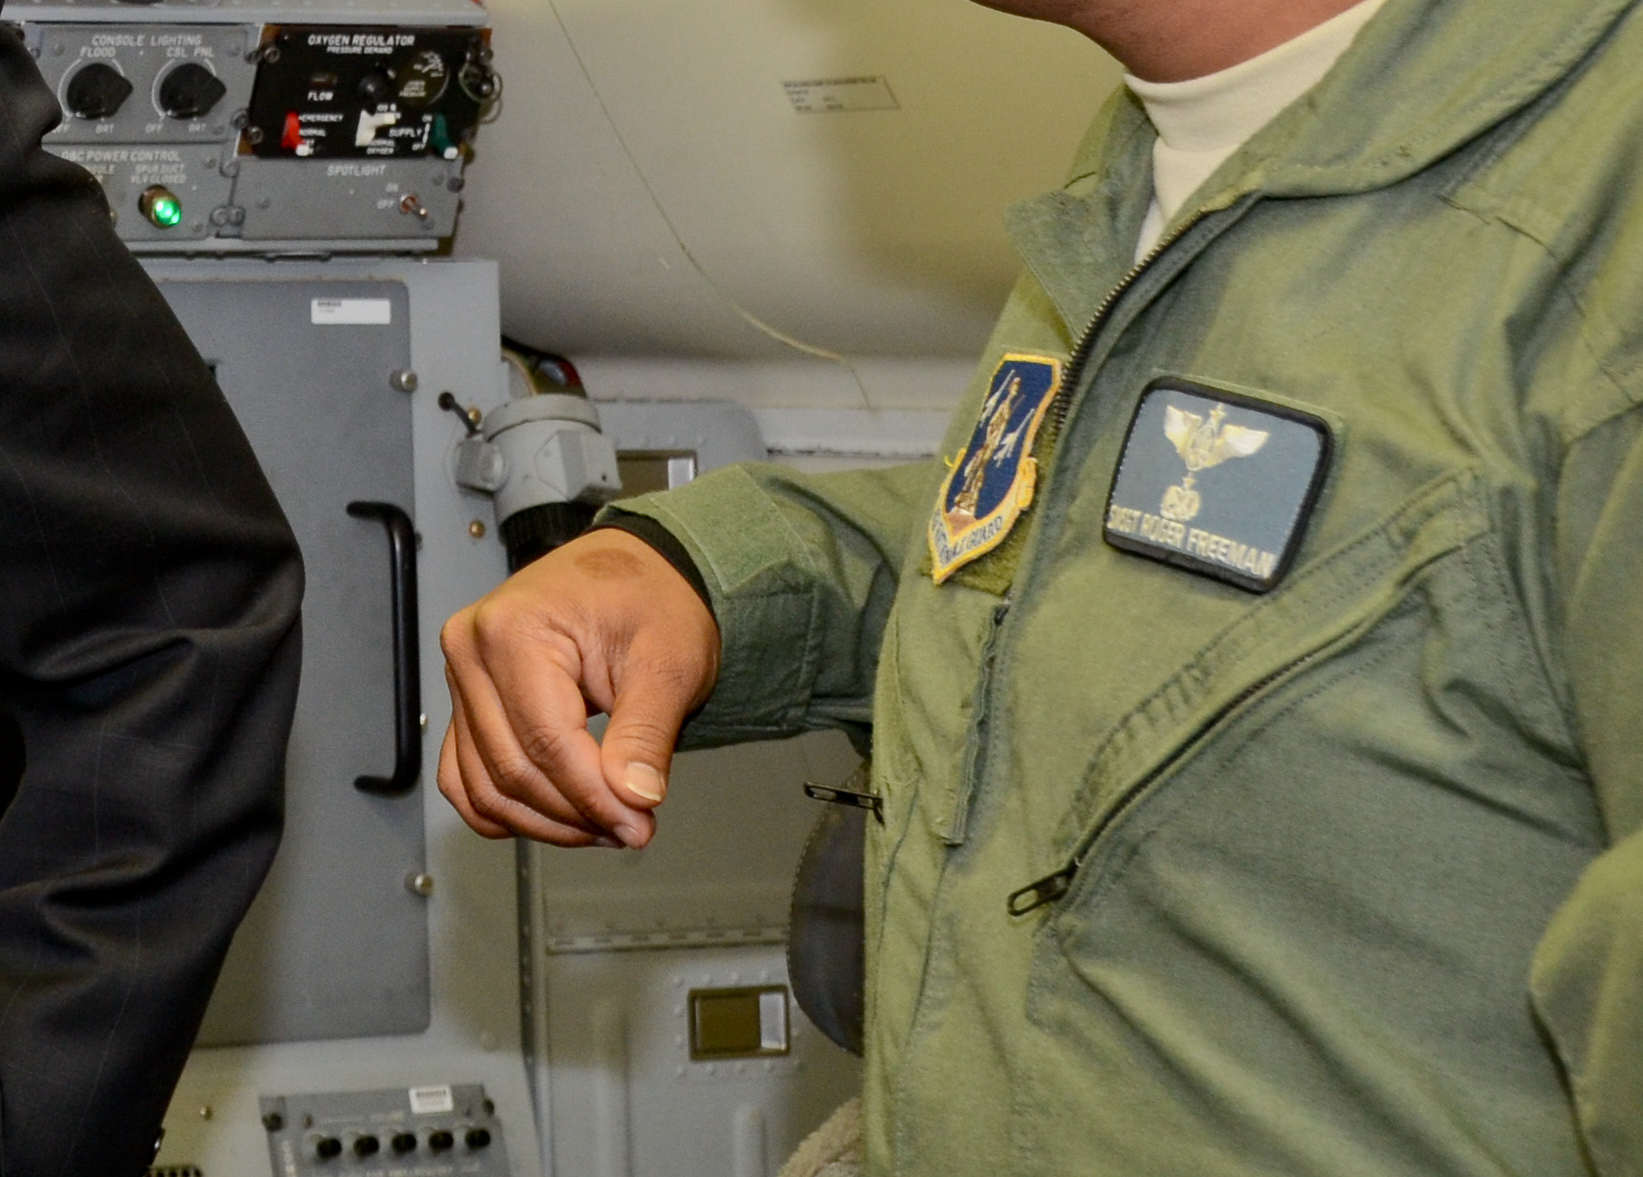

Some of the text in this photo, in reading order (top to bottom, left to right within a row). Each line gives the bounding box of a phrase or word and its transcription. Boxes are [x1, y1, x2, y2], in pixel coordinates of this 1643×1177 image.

[92, 35, 203, 47] CONSOLE LIGHTING
[308, 34, 415, 46] OXYGEN REGULATOR
[80, 47, 116, 58] FLOOD
[307, 91, 334, 101] FLOW
[389, 128, 422, 138] SUPPLY
[86, 150, 128, 162] POWER
[130, 150, 182, 162] CONTROL
[327, 164, 387, 176] SPOTLIGHT
[1139, 512, 1185, 549] ROGER
[1186, 527, 1277, 579] FREEMAN
